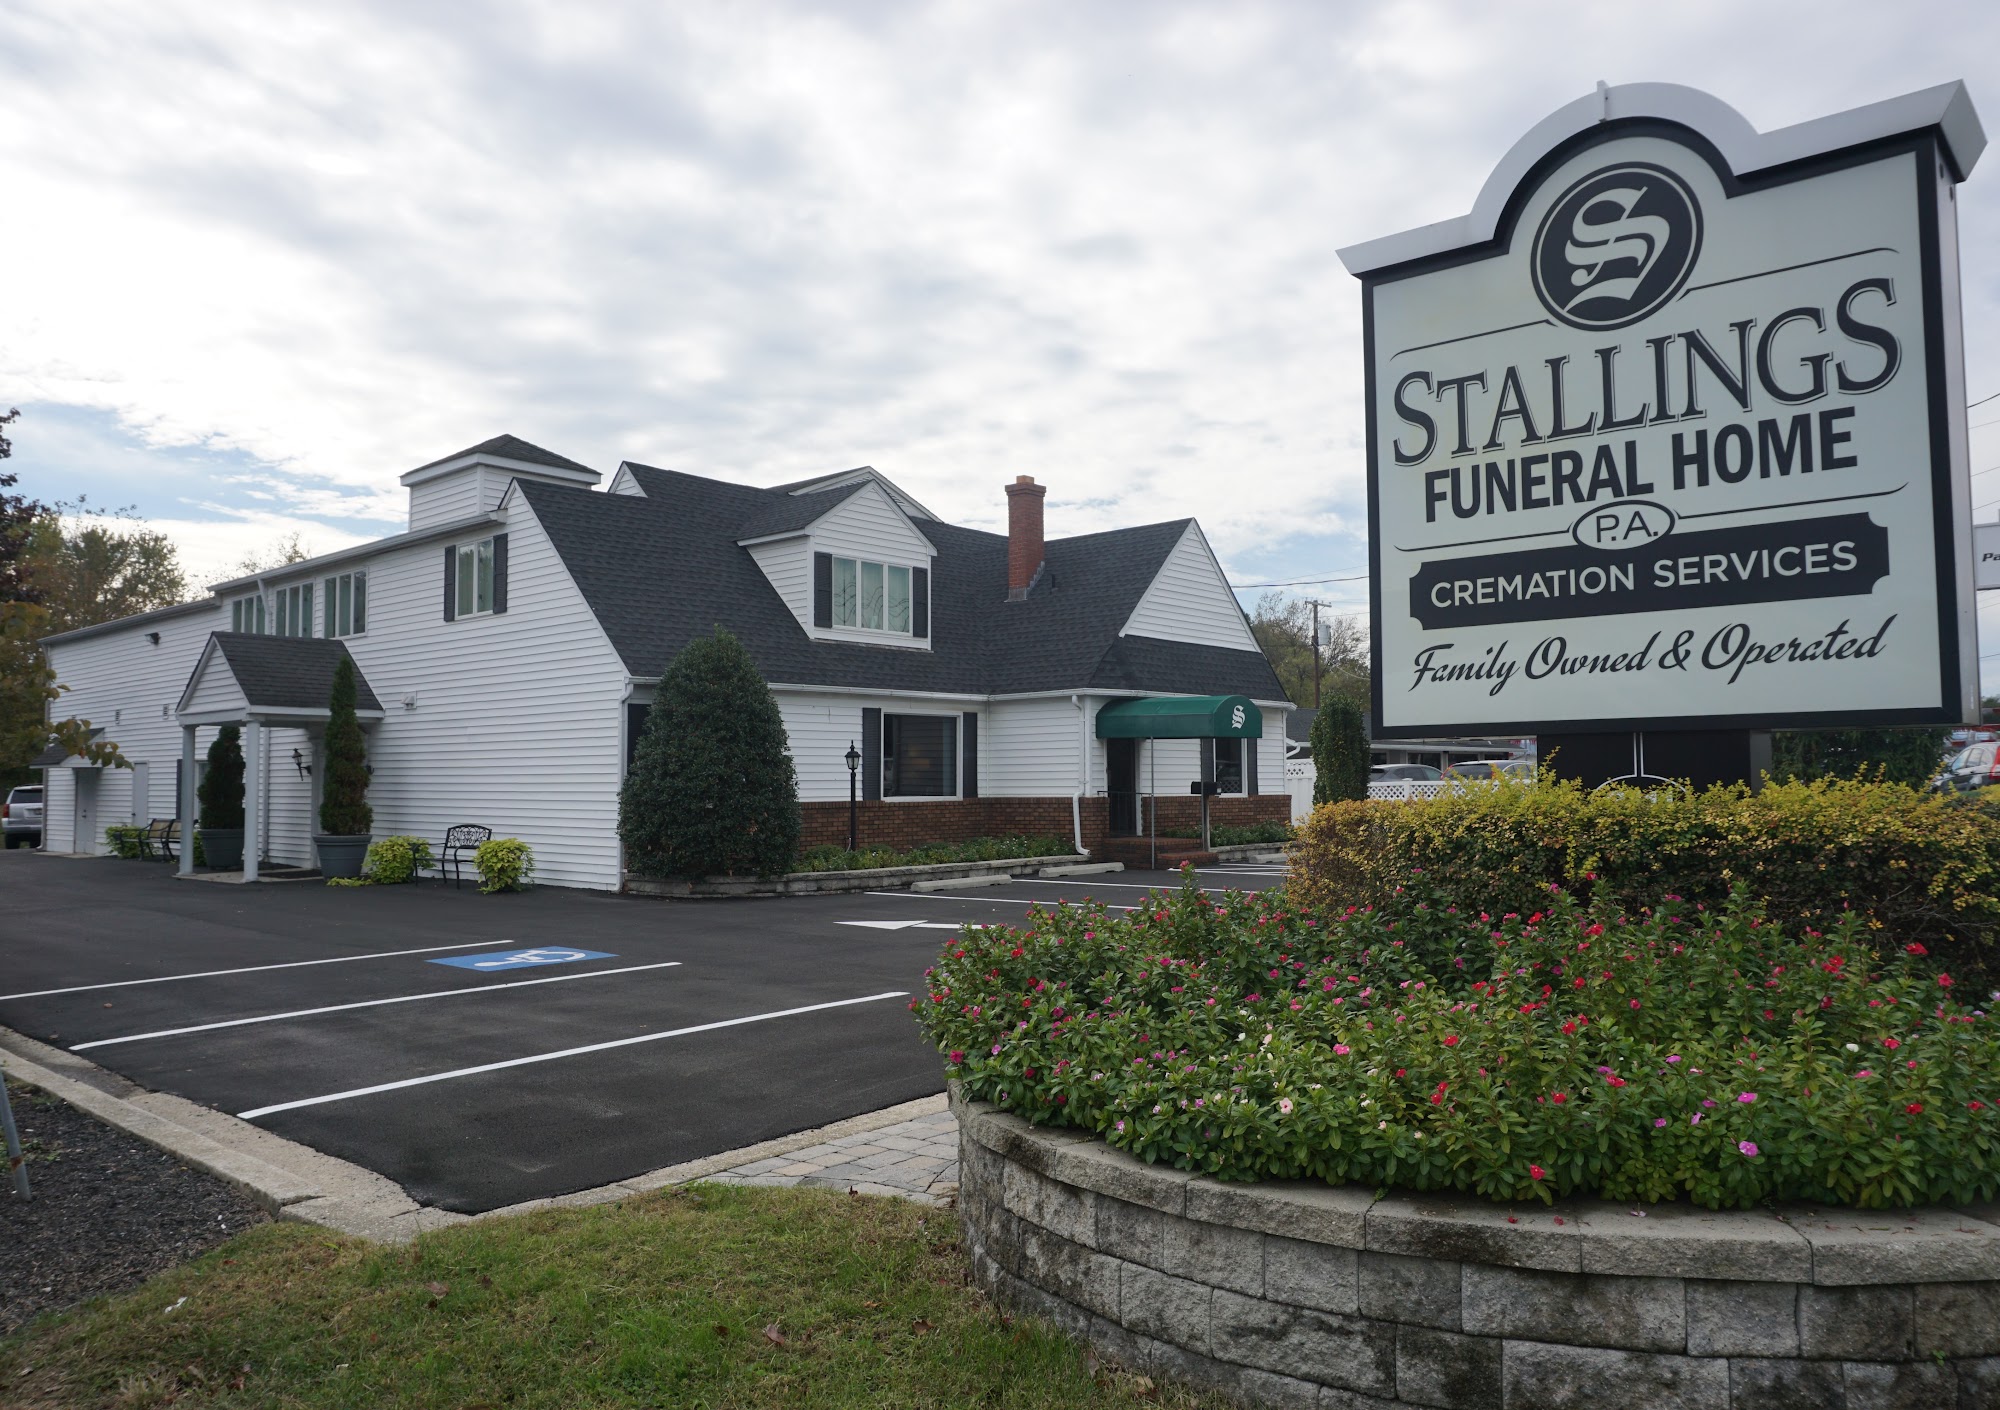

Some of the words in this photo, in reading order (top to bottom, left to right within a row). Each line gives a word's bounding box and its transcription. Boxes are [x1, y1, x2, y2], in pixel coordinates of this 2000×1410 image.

[1424, 440, 1655, 523] FUNERAL
[1671, 405, 1859, 491] HOME
[1595, 509, 1660, 544] P.A.
[1430, 563, 1635, 609] CREMATION
[1653, 540, 1859, 588] SERVICES
[1409, 640, 1521, 697] Family
[1524, 630, 1662, 680] Owned
[1657, 628, 1695, 672] &
[1701, 613, 1899, 686] Operated
